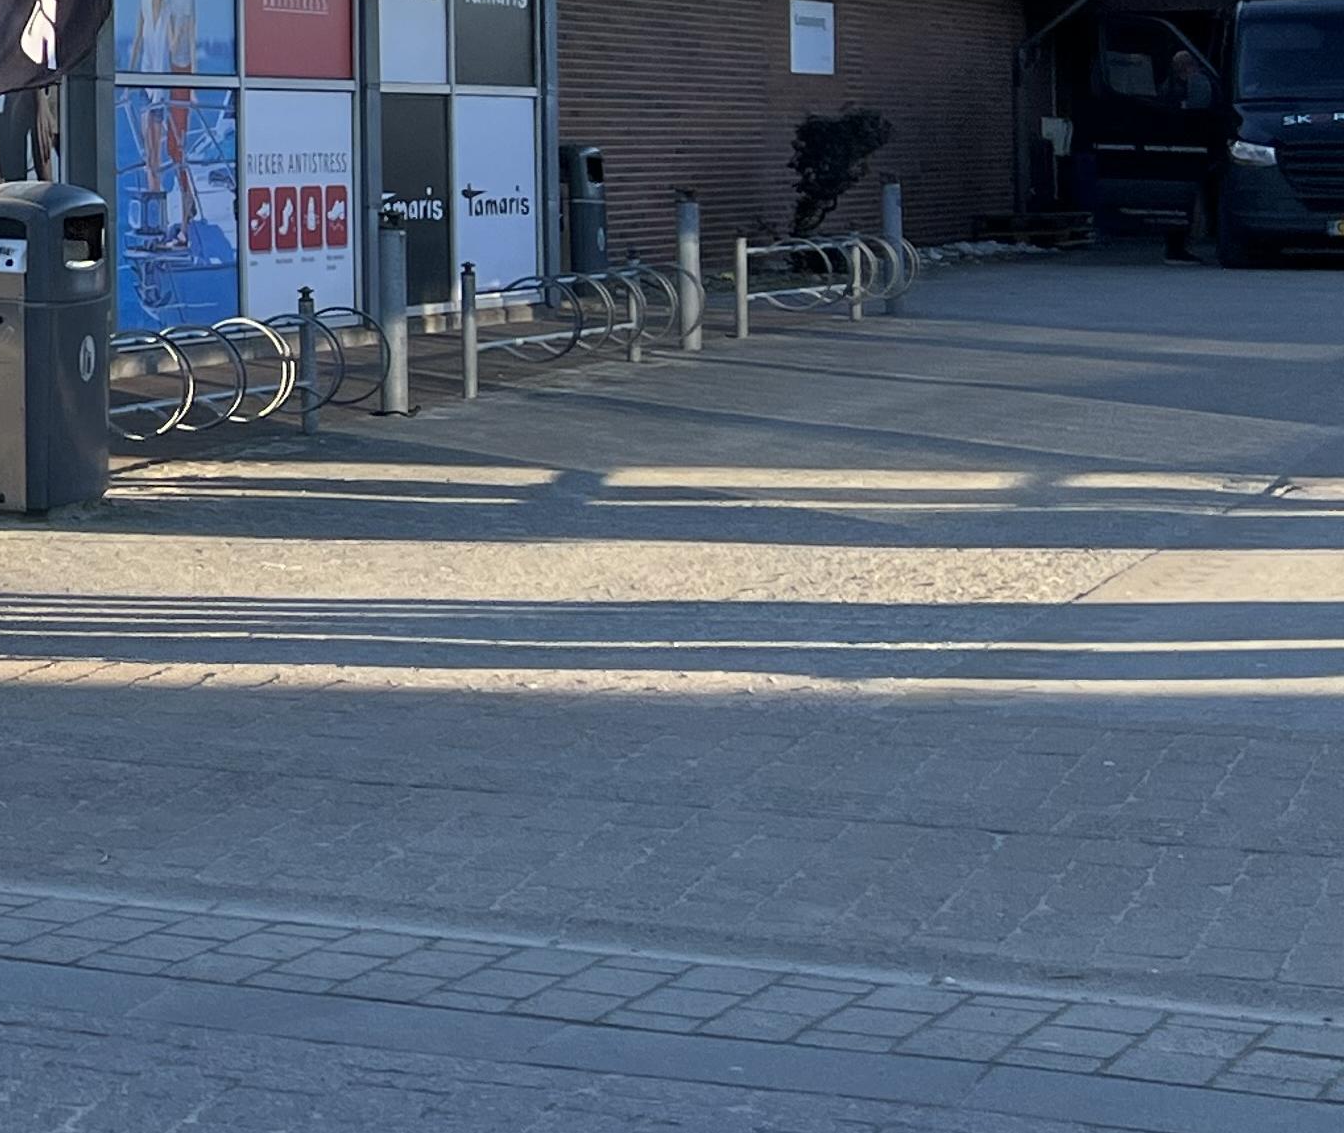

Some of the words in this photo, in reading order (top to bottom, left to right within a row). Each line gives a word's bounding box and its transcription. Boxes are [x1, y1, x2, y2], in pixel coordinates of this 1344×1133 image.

[247, 152, 285, 175] RIEKER
[288, 152, 347, 174] ANTISTRESS
[462, 183, 530, 216] Tamaris
